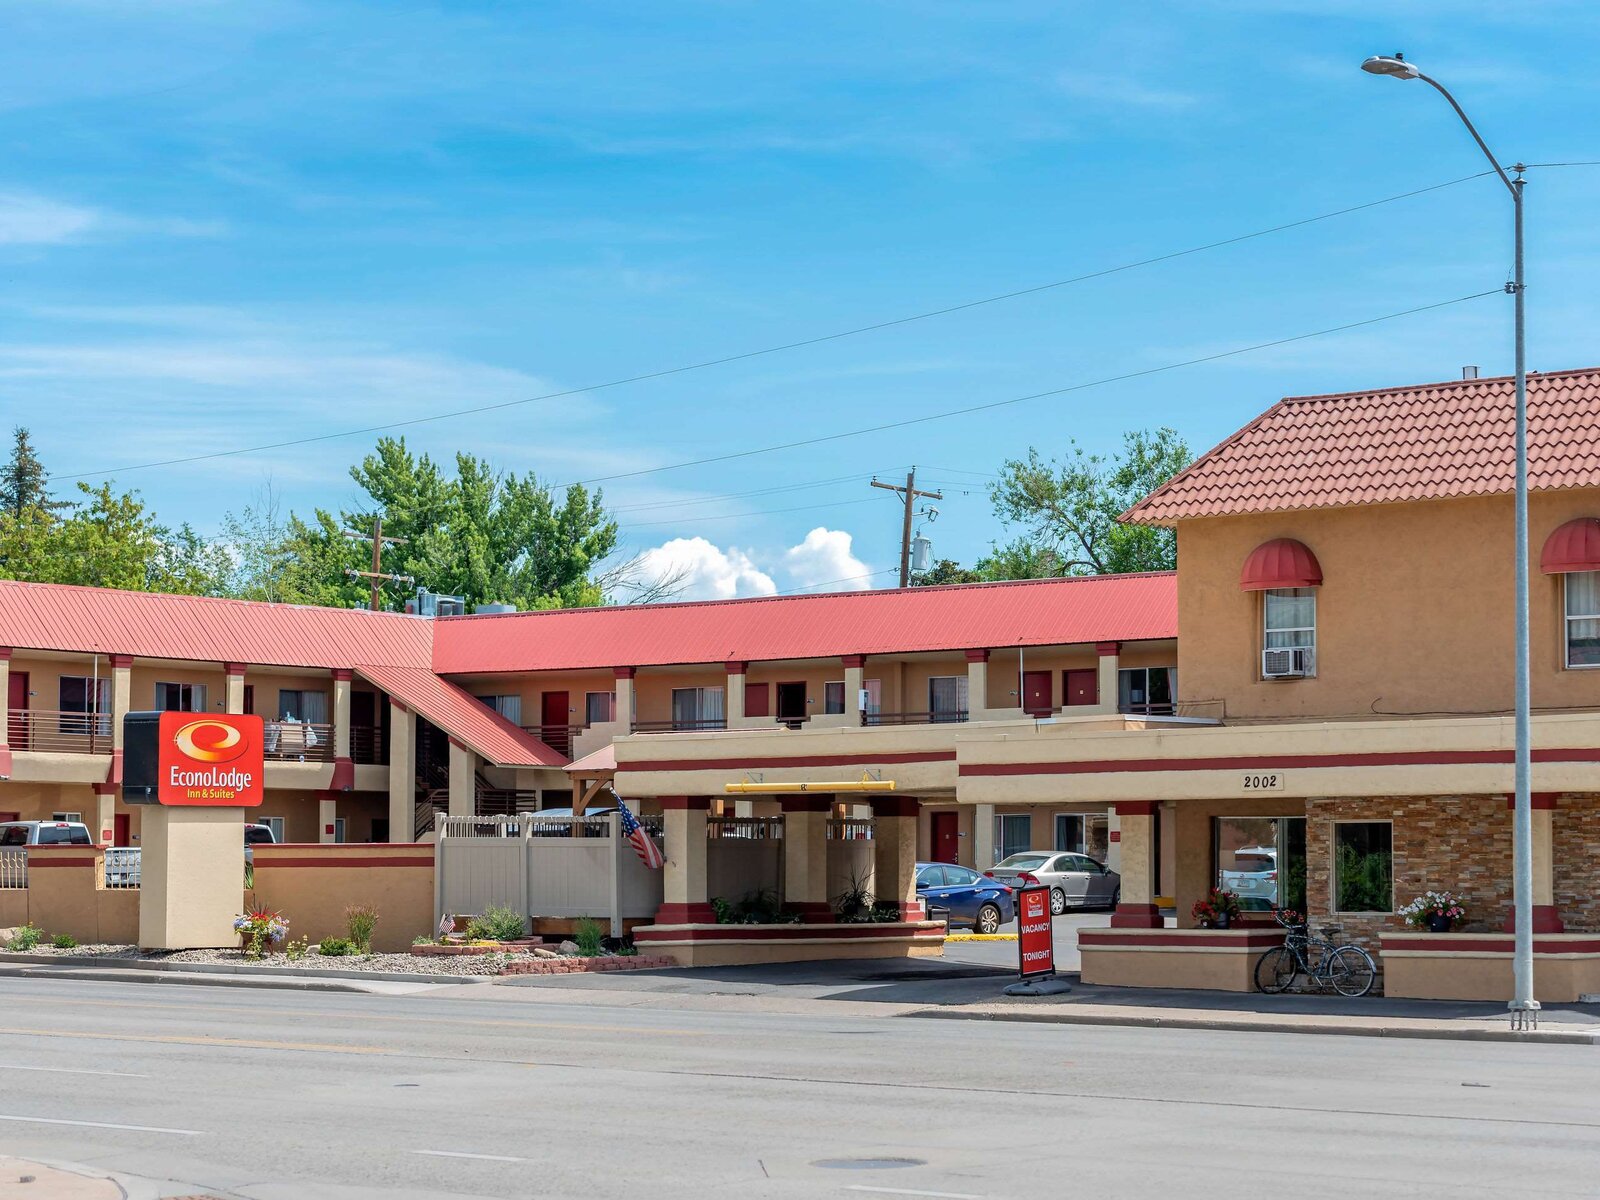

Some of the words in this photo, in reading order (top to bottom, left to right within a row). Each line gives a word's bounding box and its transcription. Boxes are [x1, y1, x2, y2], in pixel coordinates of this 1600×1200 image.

[170, 765, 252, 792] EconoLodge
[1244, 775, 1277, 788] 2002
[187, 788, 201, 799] Inn
[201, 788, 209, 799] &
[209, 788, 235, 799] Suites
[1021, 922, 1050, 934] VACANCY
[1022, 949, 1050, 962] TONIGHT
